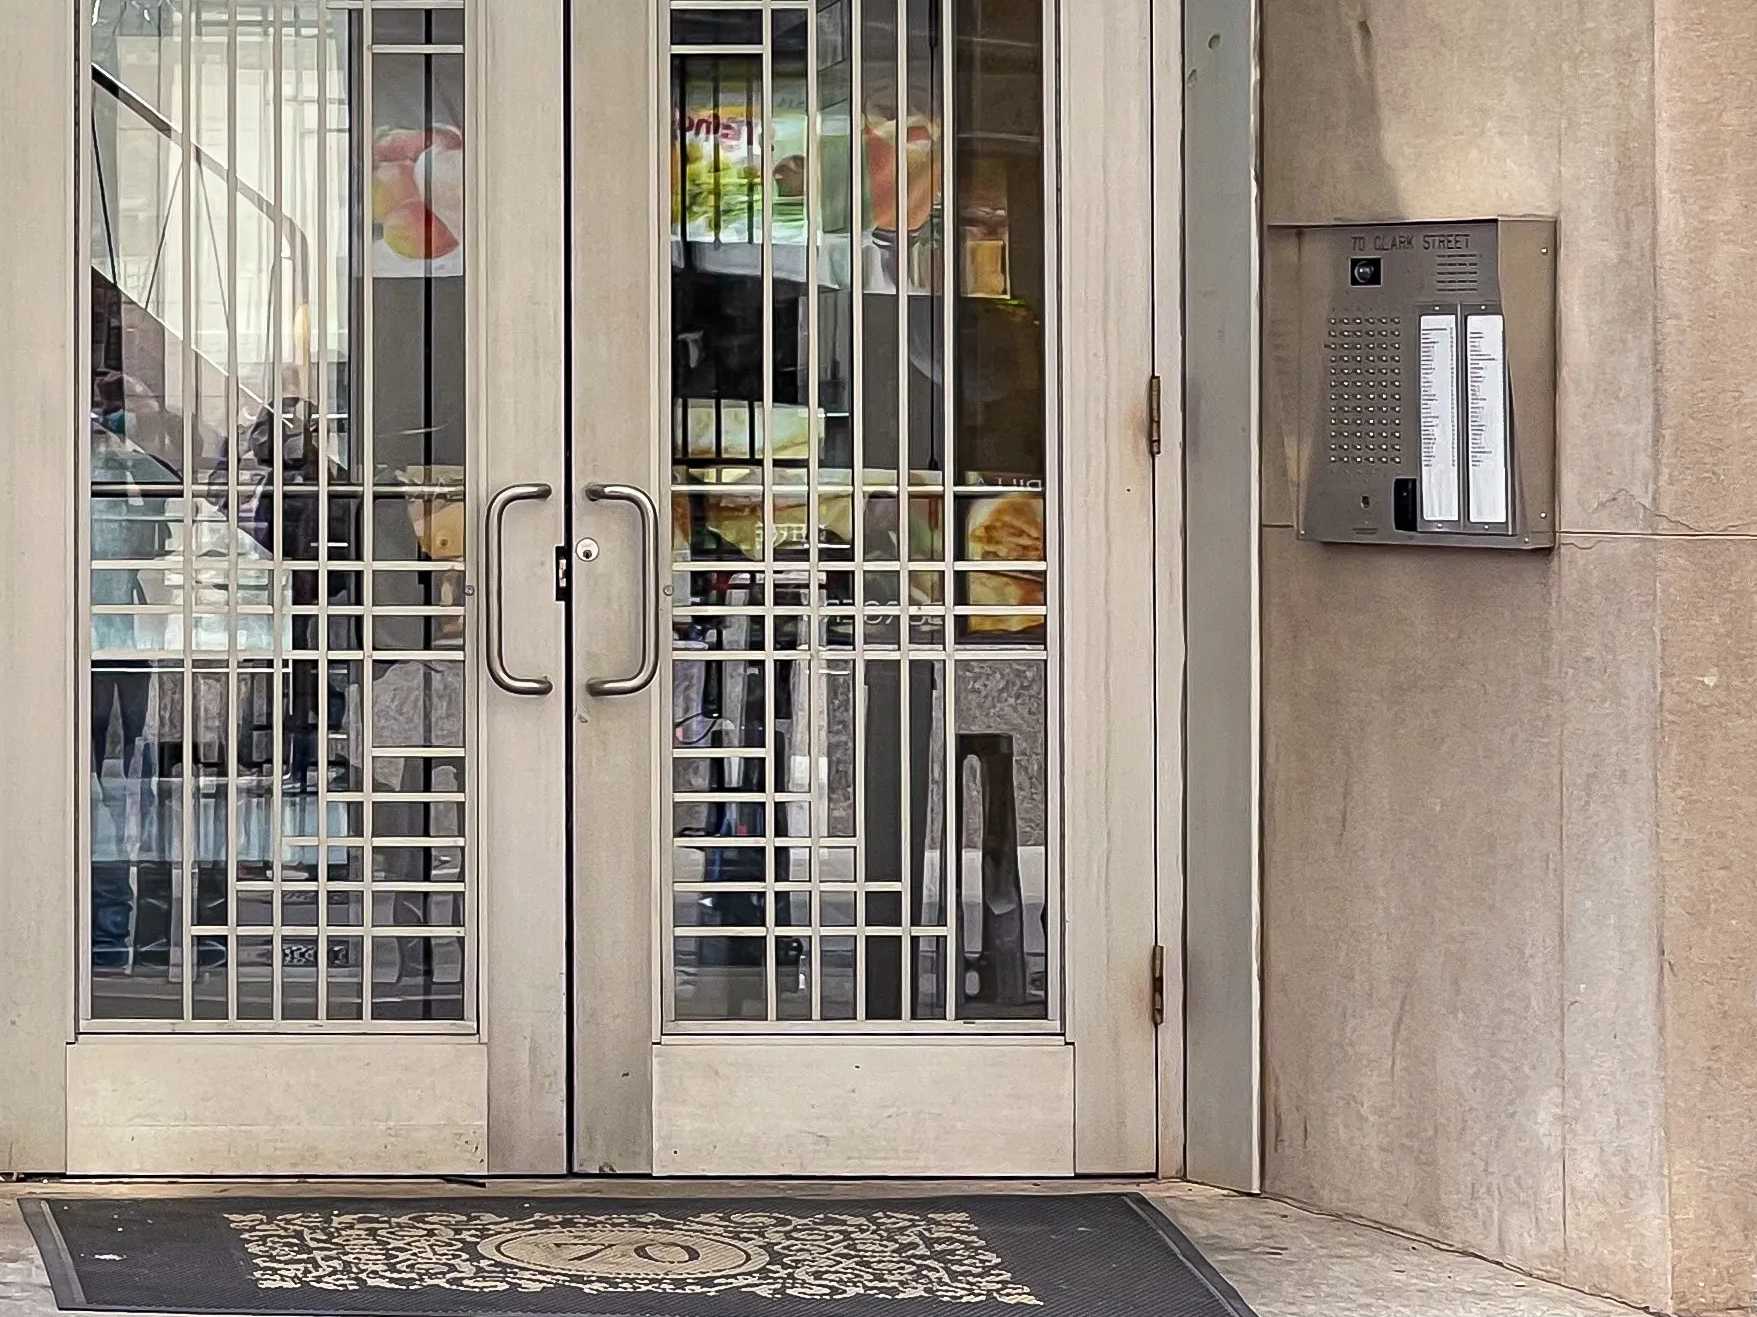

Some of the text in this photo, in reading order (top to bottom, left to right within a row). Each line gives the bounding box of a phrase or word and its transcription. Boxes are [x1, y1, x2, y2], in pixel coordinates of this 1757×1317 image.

[1350, 234, 1471, 251] 70 CLARK STREET
[552, 1242, 701, 1264] 70
